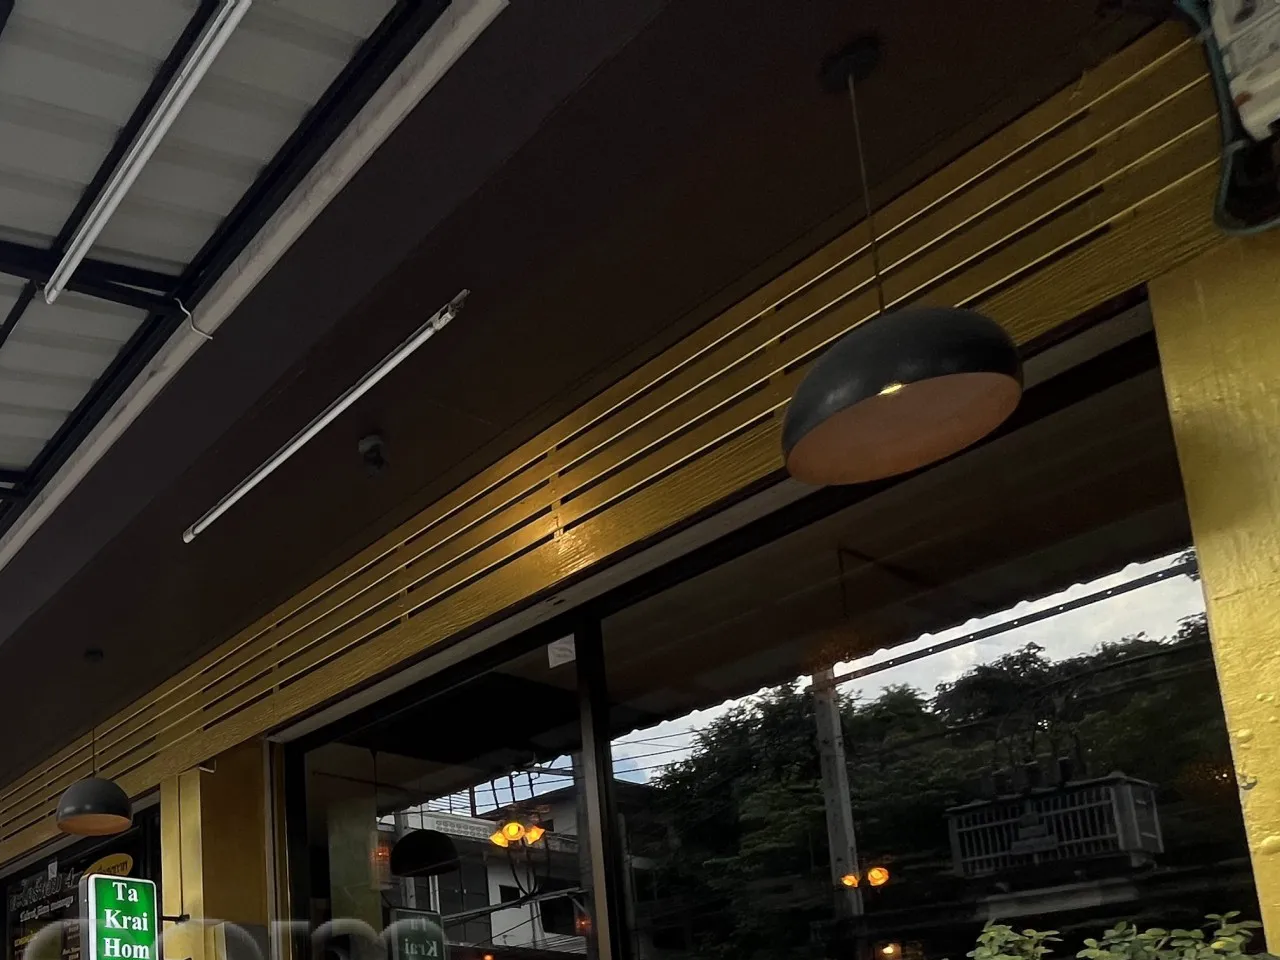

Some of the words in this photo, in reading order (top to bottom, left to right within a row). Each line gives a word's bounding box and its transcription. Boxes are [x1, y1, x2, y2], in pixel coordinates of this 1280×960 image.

[112, 882, 138, 902] Ta
[104, 909, 148, 931] Krai
[103, 937, 150, 959] Hom
